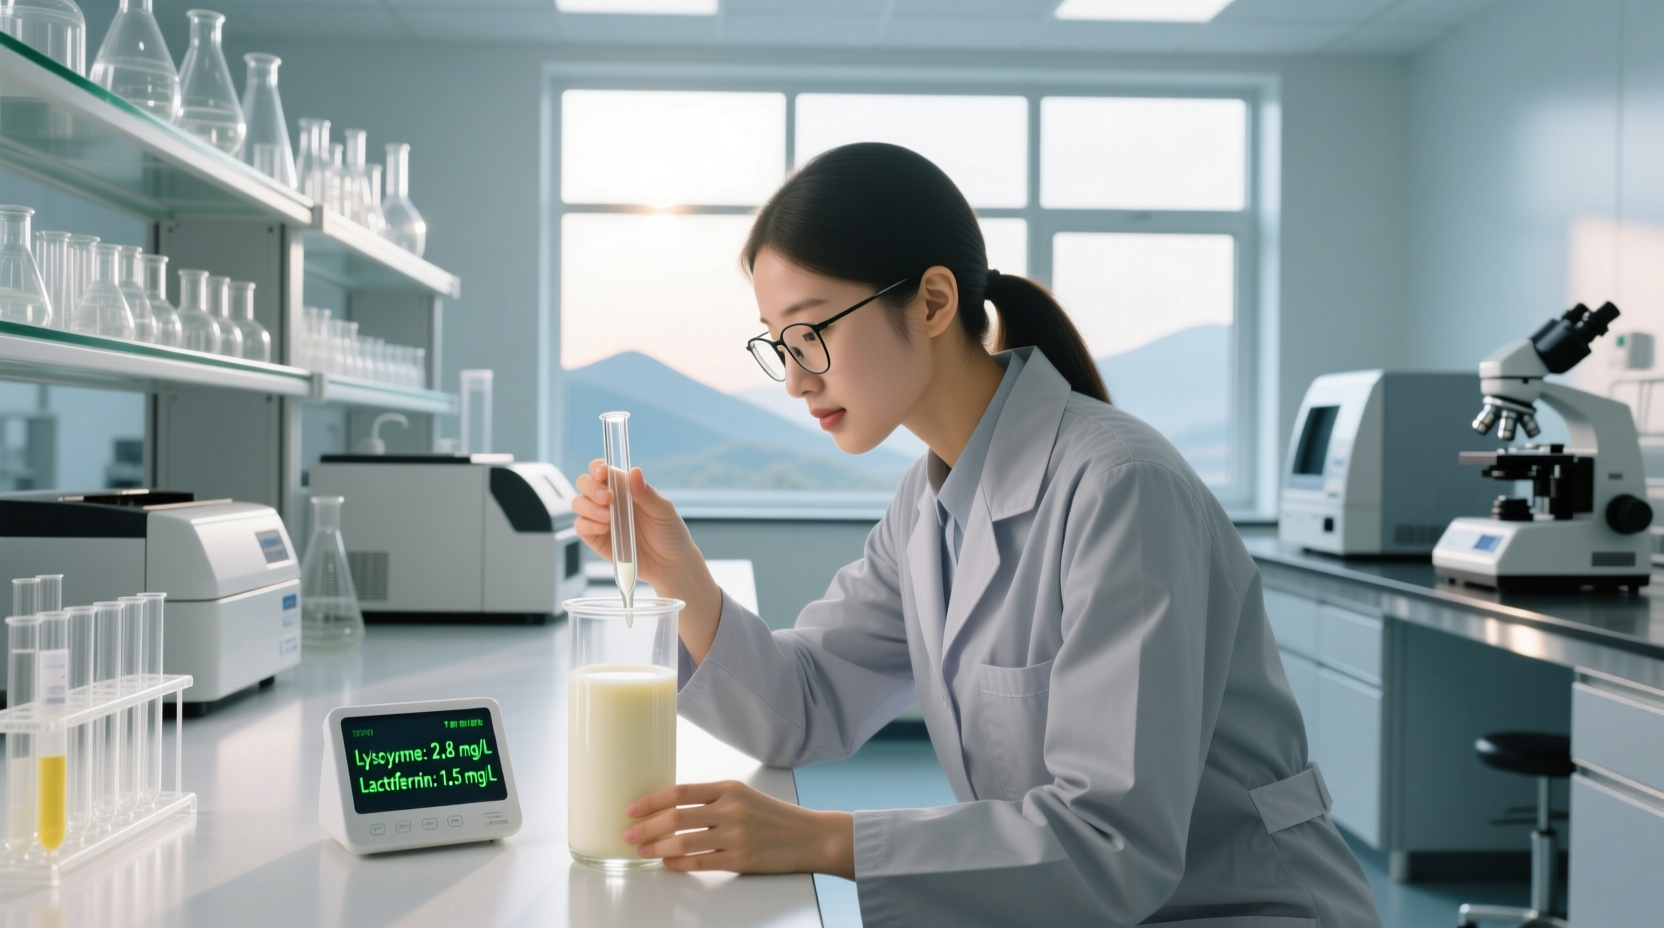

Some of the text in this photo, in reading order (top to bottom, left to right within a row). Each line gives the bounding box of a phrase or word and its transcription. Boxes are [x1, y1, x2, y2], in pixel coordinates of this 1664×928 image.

[430, 741, 455, 760] 2.8
[459, 738, 493, 761] mg/L
[439, 768, 462, 786] 1.5
[464, 764, 498, 788] mg/L
